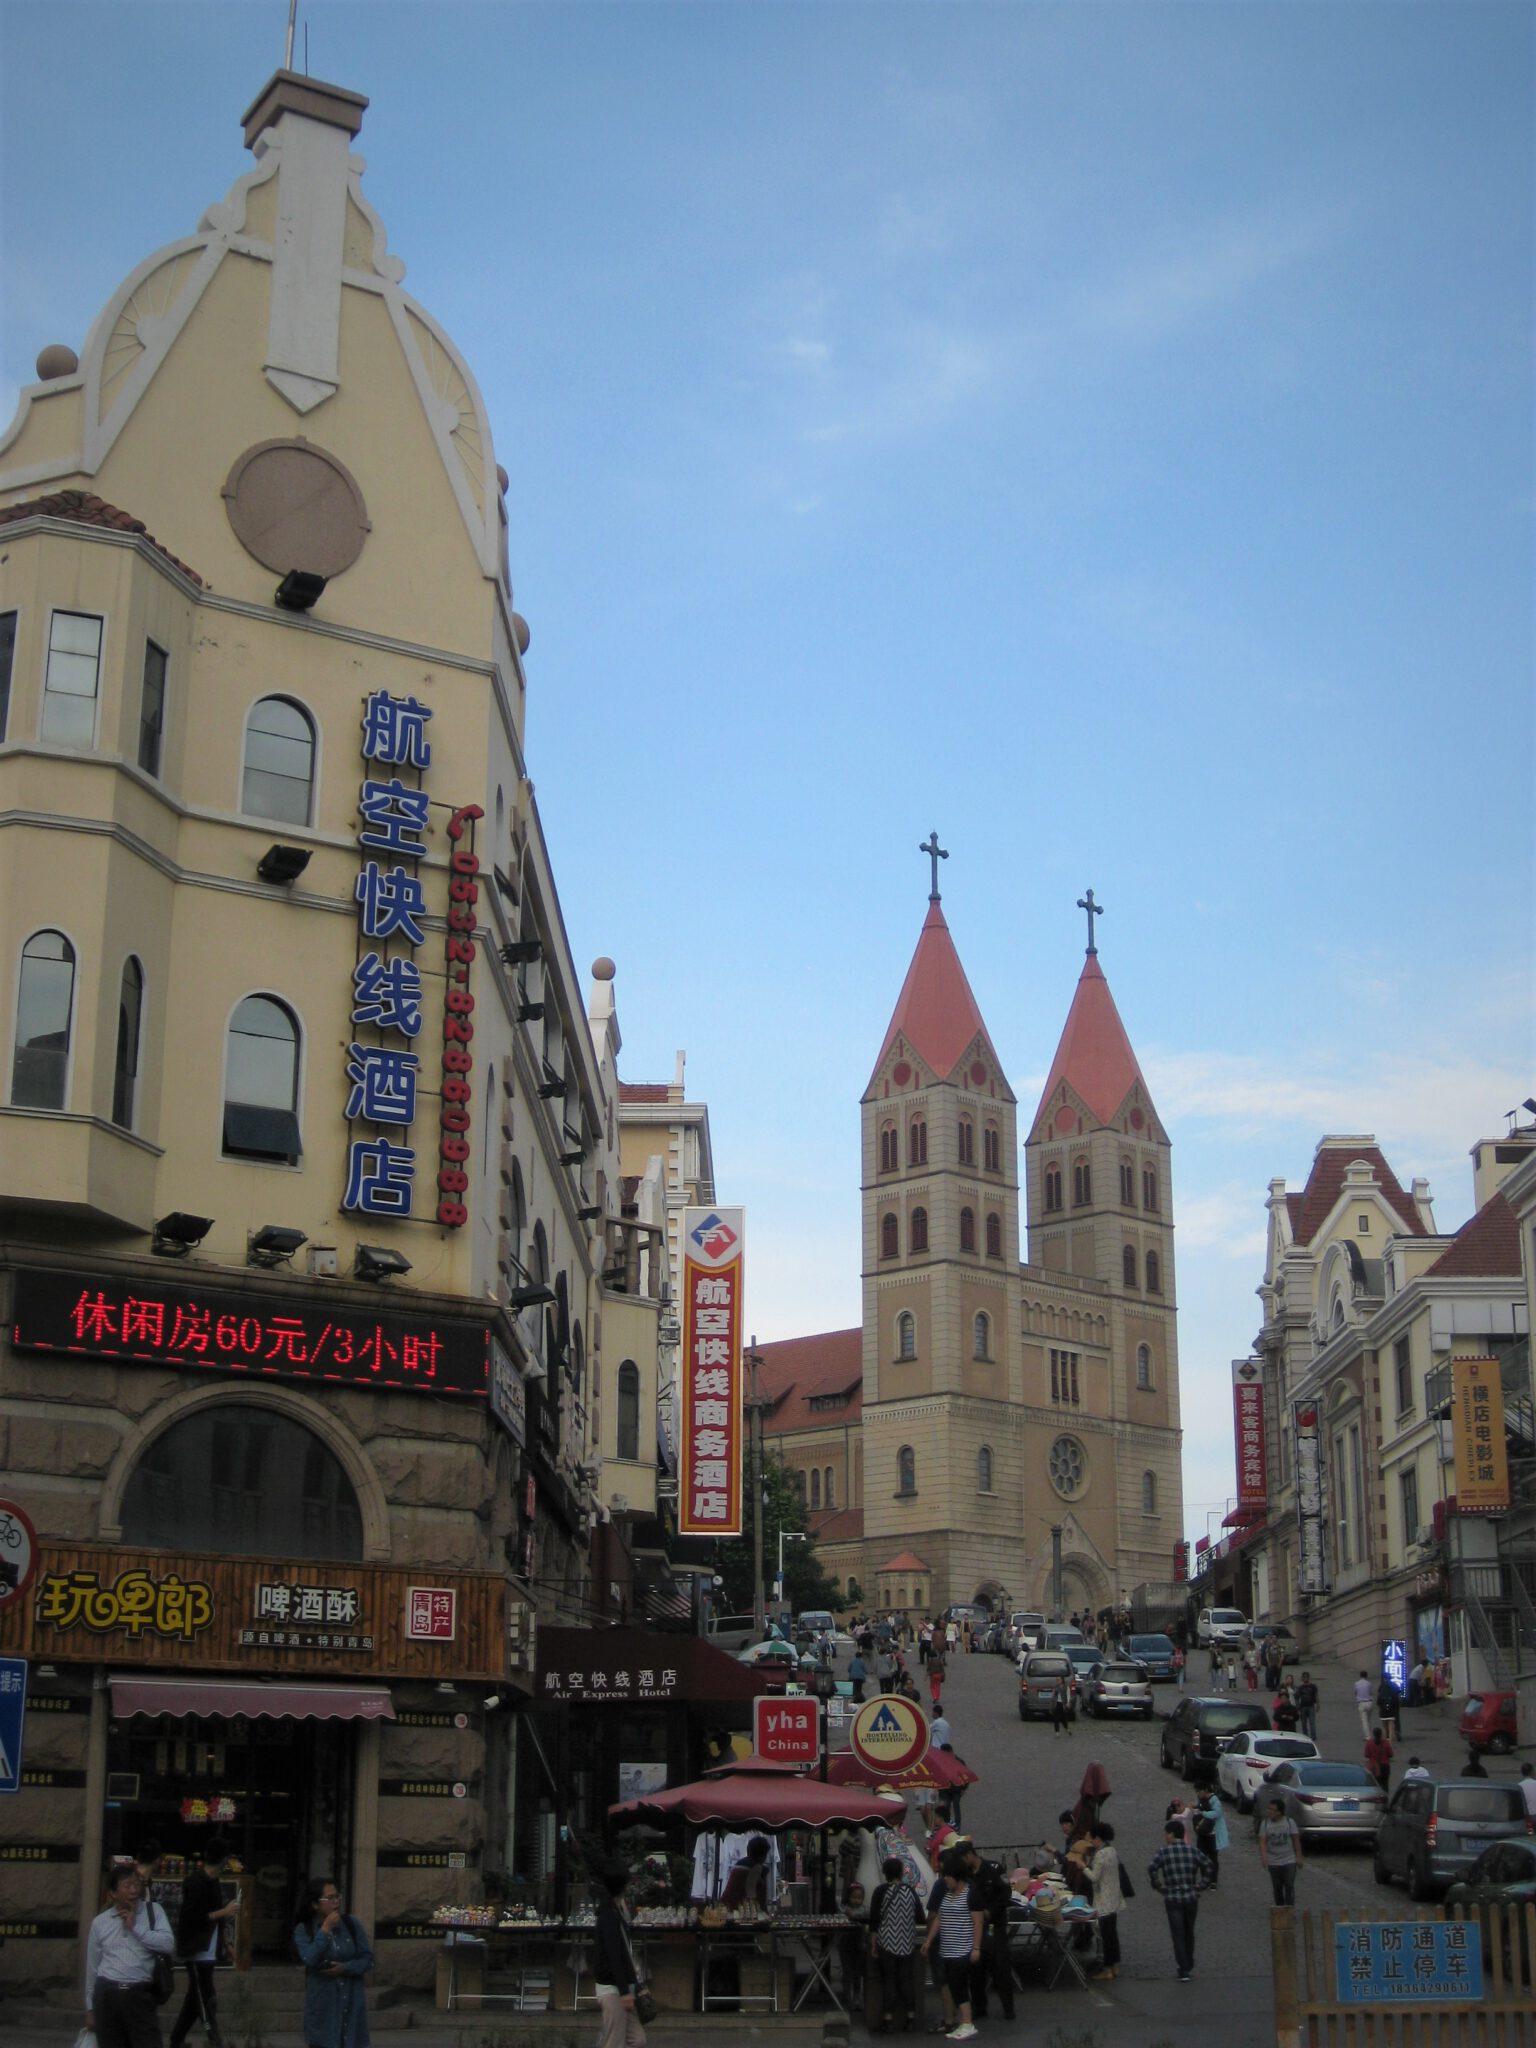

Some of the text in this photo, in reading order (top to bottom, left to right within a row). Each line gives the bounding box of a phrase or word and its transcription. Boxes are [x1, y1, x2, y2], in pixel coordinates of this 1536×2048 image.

[342, 688, 433, 1218] 航空快线酒店
[437, 850, 480, 1227] 0532-82860988
[70, 1290, 444, 1377] 休闲房60元/3小时
[693, 1278, 731, 1519] 航空快线商务酒店
[1240, 1387, 1263, 1487] 喜来客商务宾馆
[1472, 1385, 1496, 1482] 横店电影城
[260, 1585, 357, 1623] 啤酒酥
[432, 1595, 450, 1633] 特产
[544, 1669, 678, 1689] 航空快线酒店
[553, 1688, 672, 1701] Air Express Hotel
[766, 1711, 808, 1732] yha
[767, 1739, 810, 1750] China
[1350, 1926, 1467, 1951] 消防通道
[1351, 1954, 1468, 1980] 禁止停车
